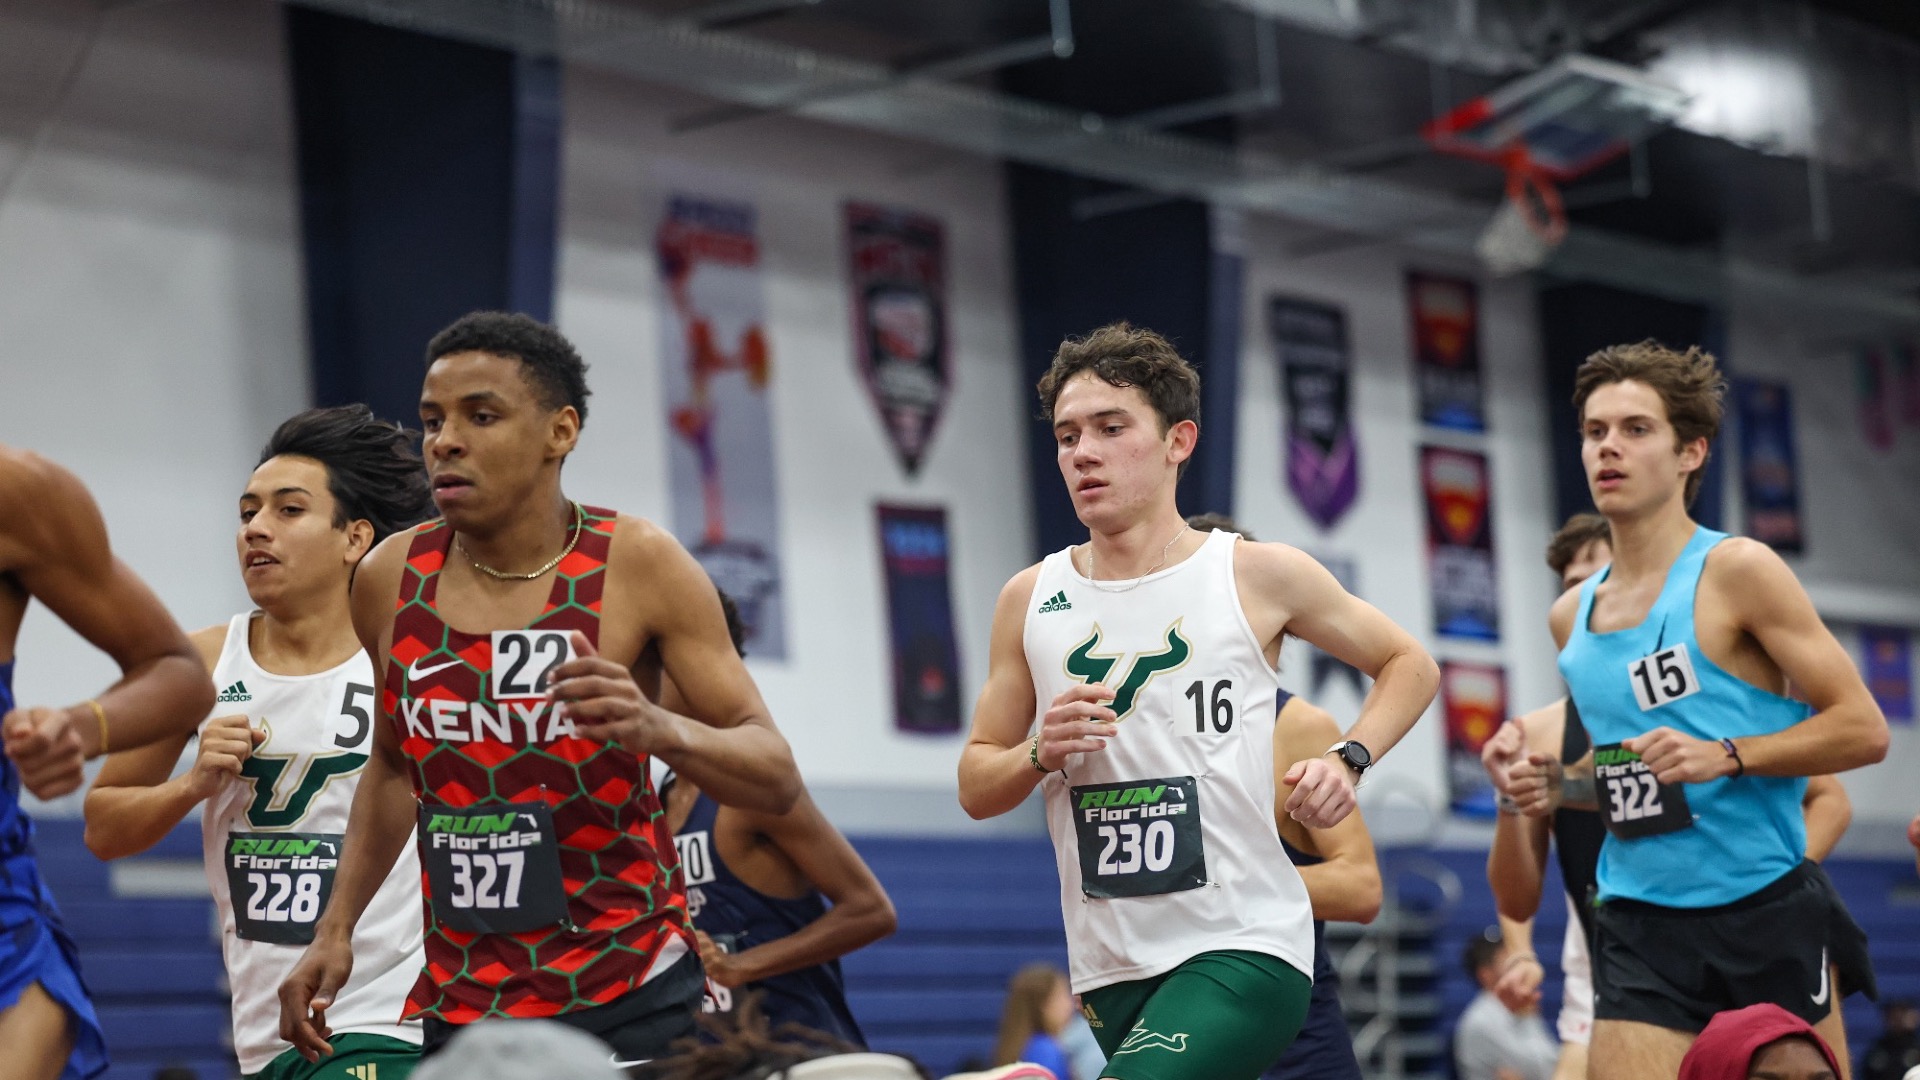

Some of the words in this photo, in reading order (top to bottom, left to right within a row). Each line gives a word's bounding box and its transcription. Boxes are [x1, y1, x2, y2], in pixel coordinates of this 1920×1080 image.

[1038, 602, 1072, 614] adidas
[499, 633, 568, 694] 22
[1633, 650, 1687, 705] 15
[217, 691, 252, 703] adidas
[1184, 679, 1234, 734] 16
[334, 682, 375, 748] 5
[402, 698, 579, 743] KENYA
[1596, 759, 1650, 779] Florid
[1079, 784, 1167, 809] RUN
[1085, 802, 1187, 823] Florida
[1607, 773, 1663, 823] 322
[426, 811, 518, 834] RUN
[230, 838, 321, 856] RUN
[432, 831, 542, 850] Florida
[1097, 820, 1175, 876] 230
[233, 854, 338, 870] Florida
[450, 850, 525, 909] 327
[247, 872, 321, 923] 228
